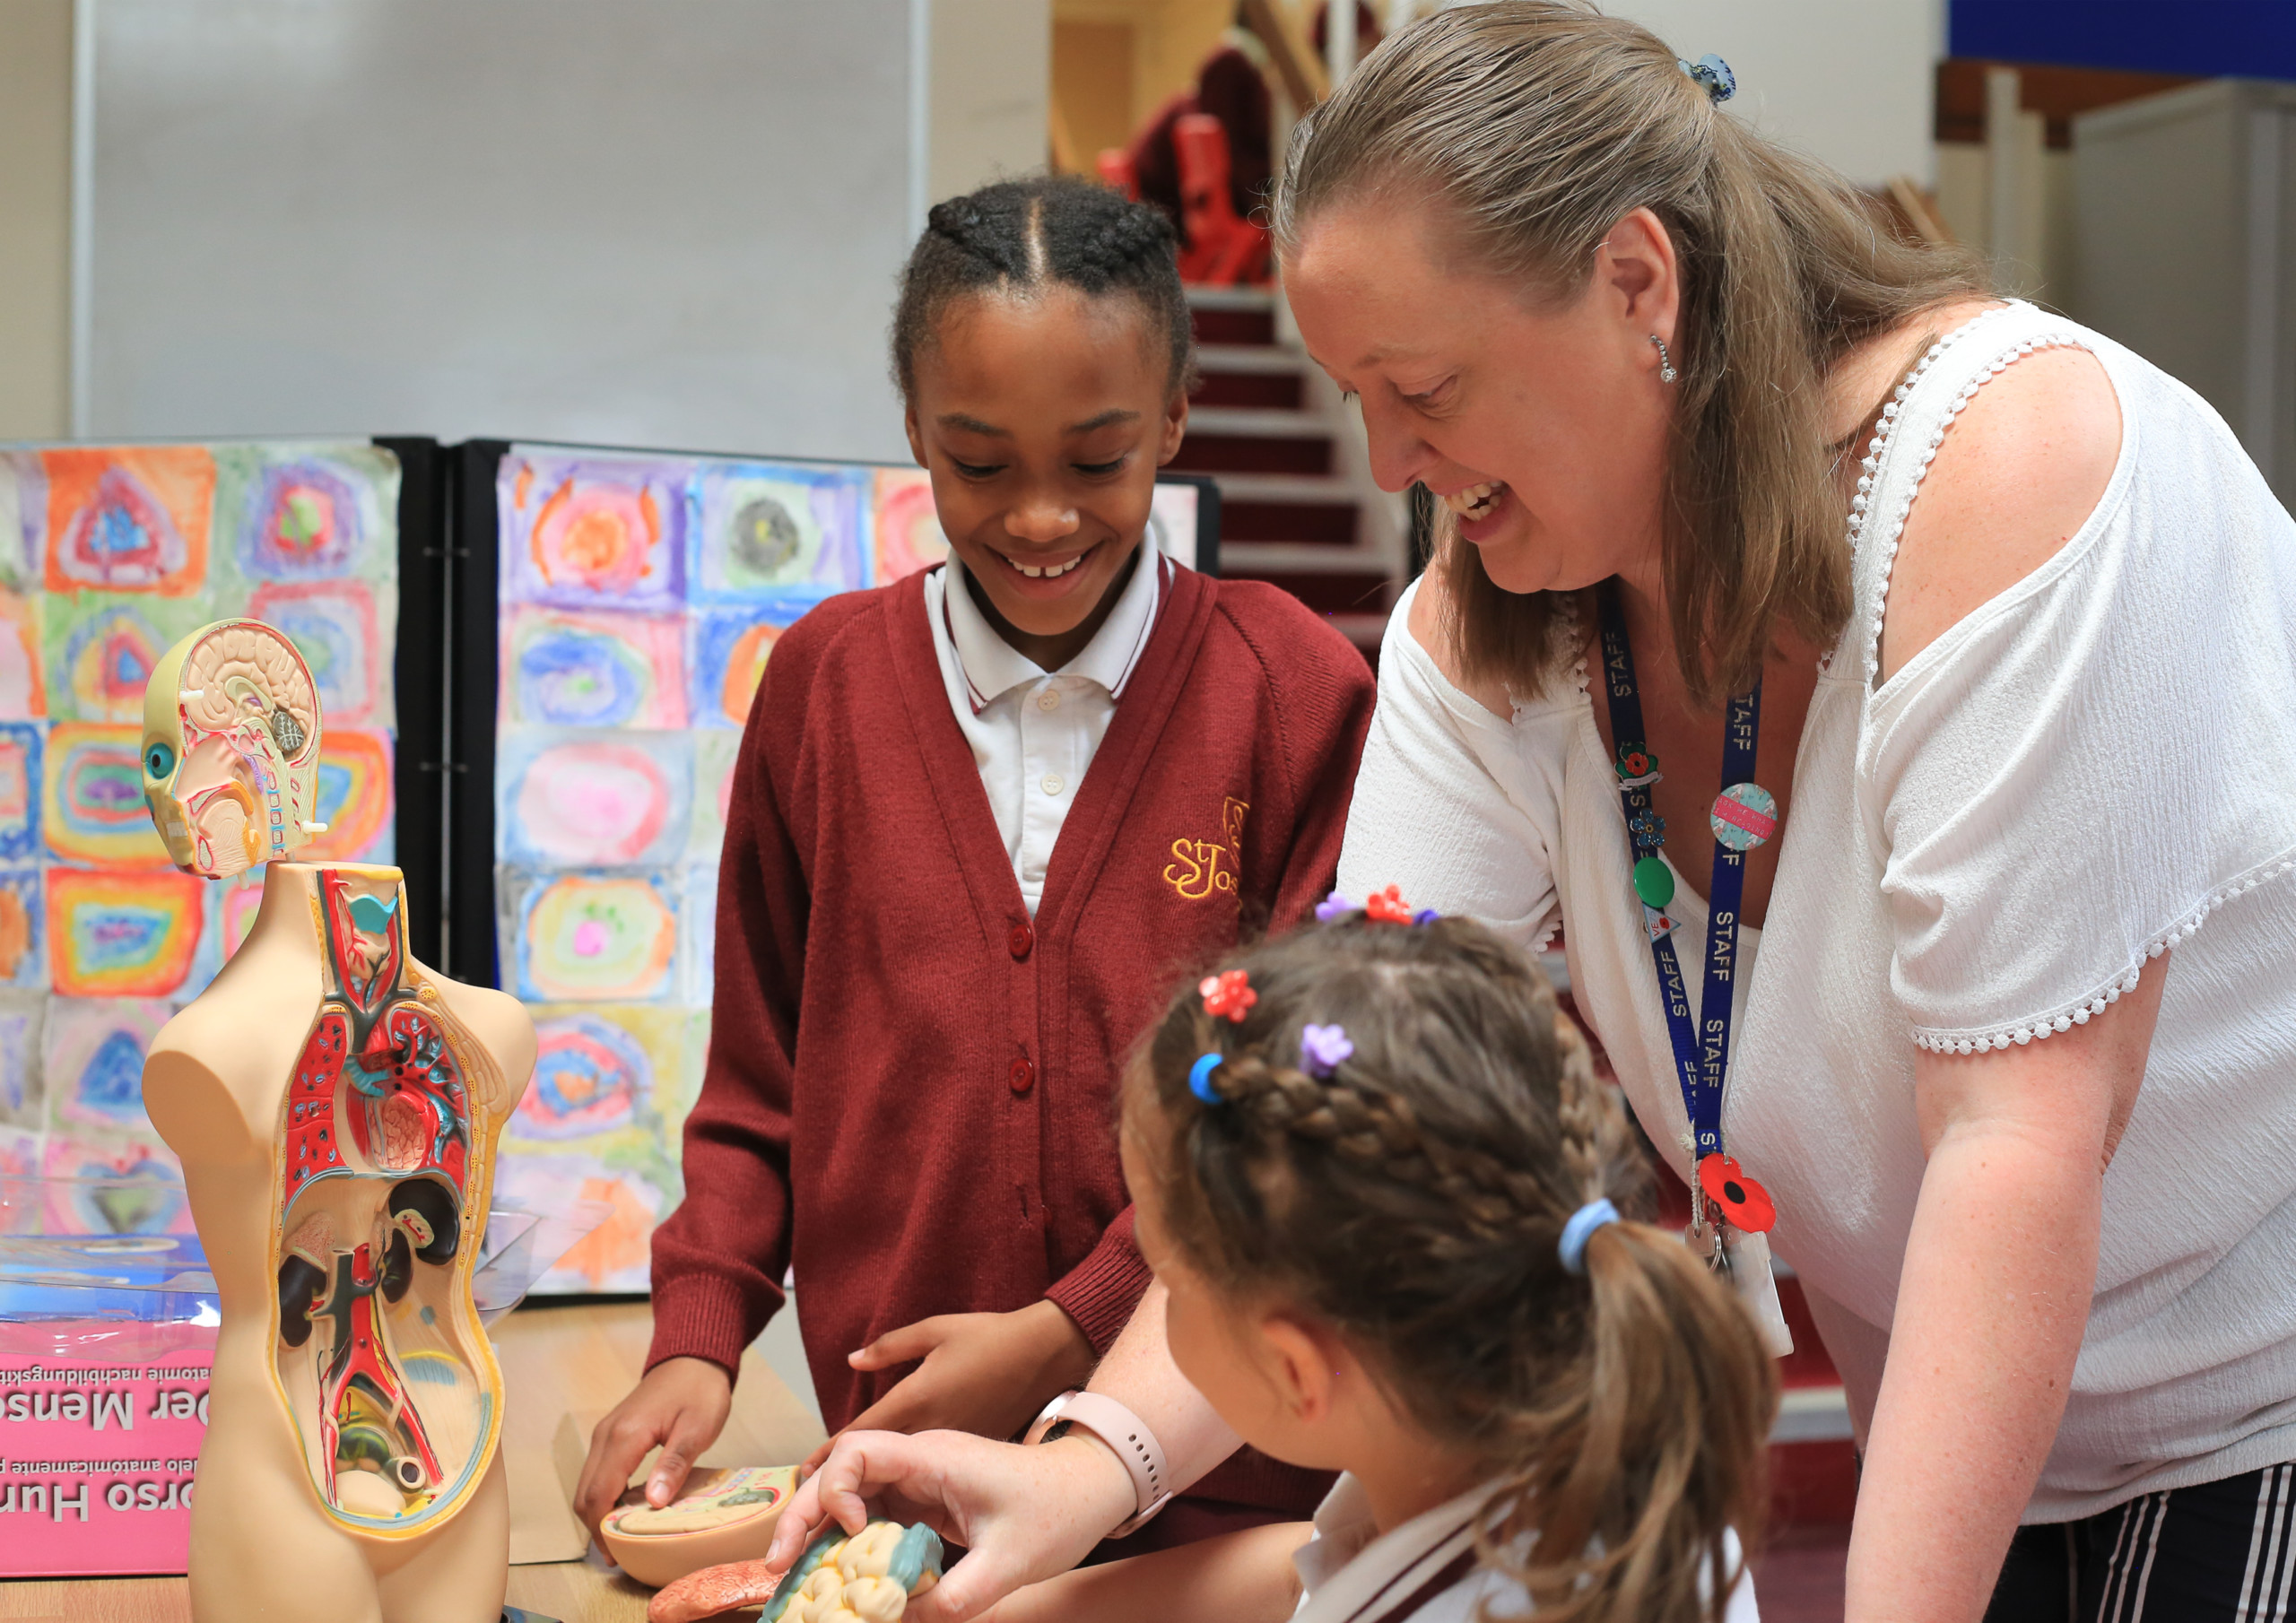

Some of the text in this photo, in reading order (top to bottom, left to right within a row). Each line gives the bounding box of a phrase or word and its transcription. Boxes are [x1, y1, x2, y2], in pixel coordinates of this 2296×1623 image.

[1605, 631, 1632, 698] STAFF
[1733, 693, 1752, 750] TAFF
[1712, 911, 1735, 982] STAFF
[1660, 950, 1688, 1018] STAFF
[1703, 1019, 1725, 1089] STAFF
[0, 1393, 134, 1431] Mens
[12, 1460, 161, 1478] anatómicamente
